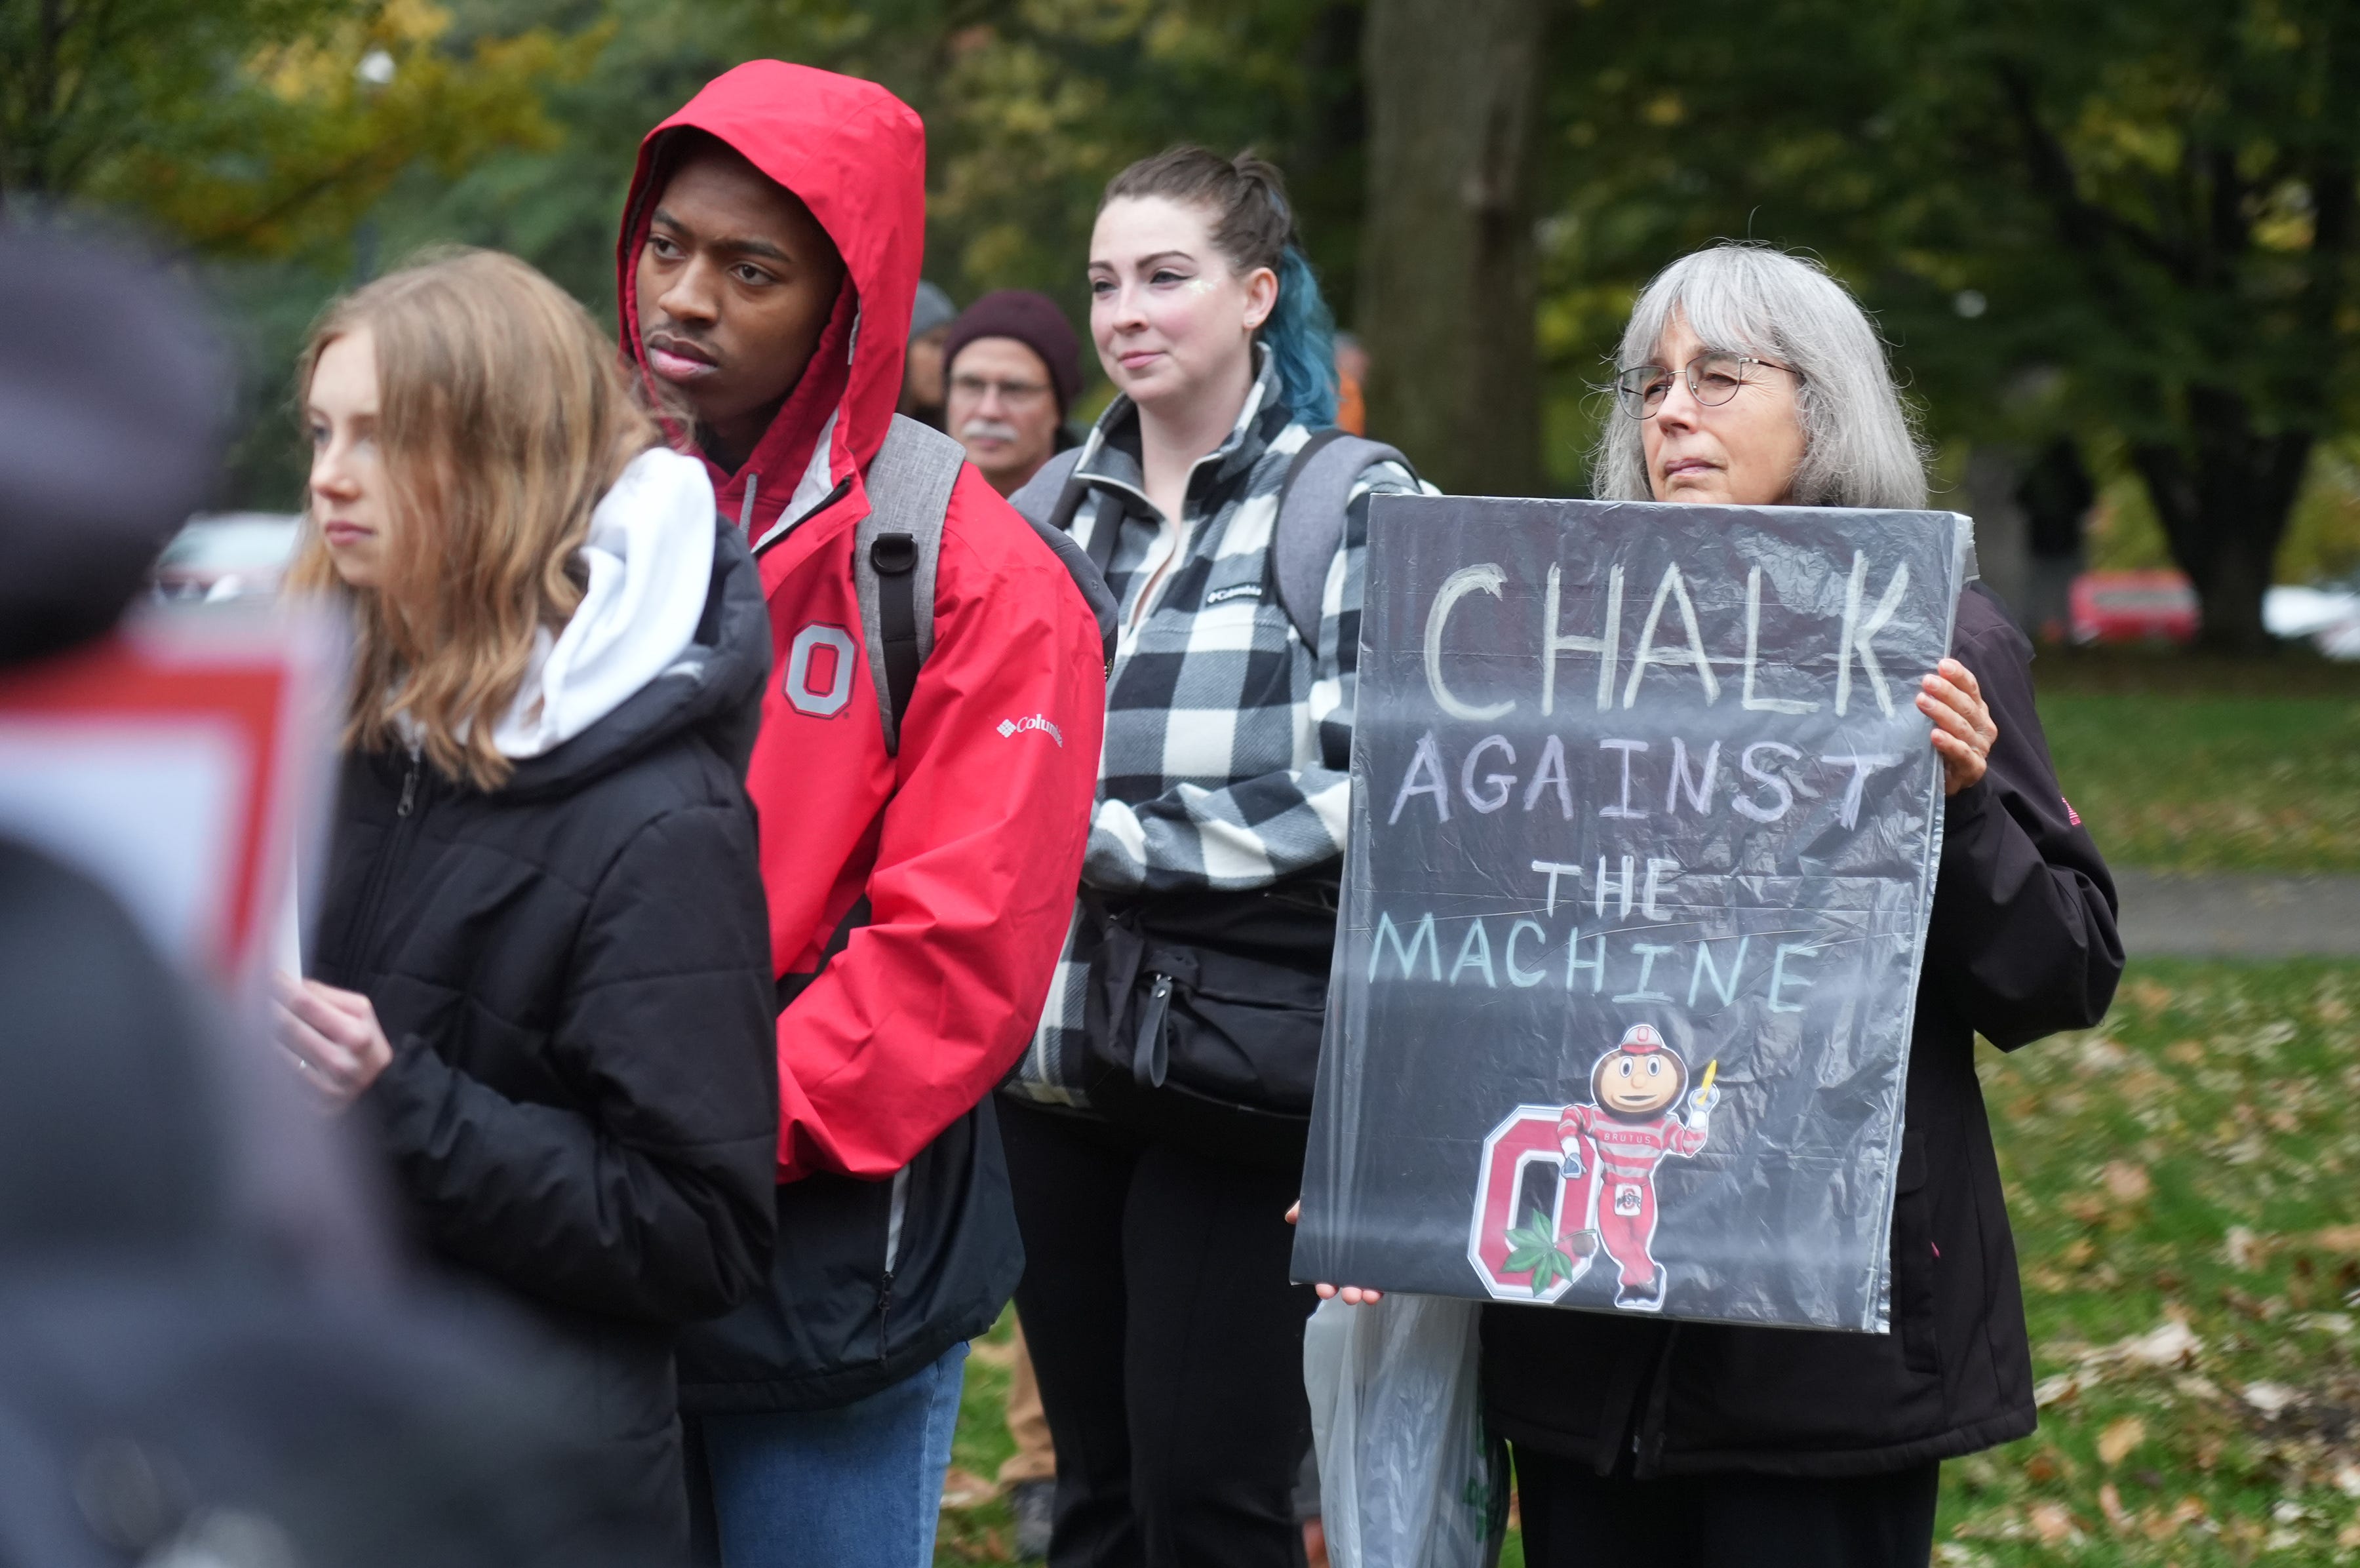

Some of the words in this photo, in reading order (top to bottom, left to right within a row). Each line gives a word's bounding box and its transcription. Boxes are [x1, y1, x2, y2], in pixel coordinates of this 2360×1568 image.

[783, 621, 858, 720] O
[1423, 549, 1908, 720] CHALK
[1388, 730, 1904, 831] AGAINST
[1531, 854, 1682, 922] THE
[1368, 911, 1819, 1013] MACHINE
[1604, 1132, 1651, 1144] BRUTUS
